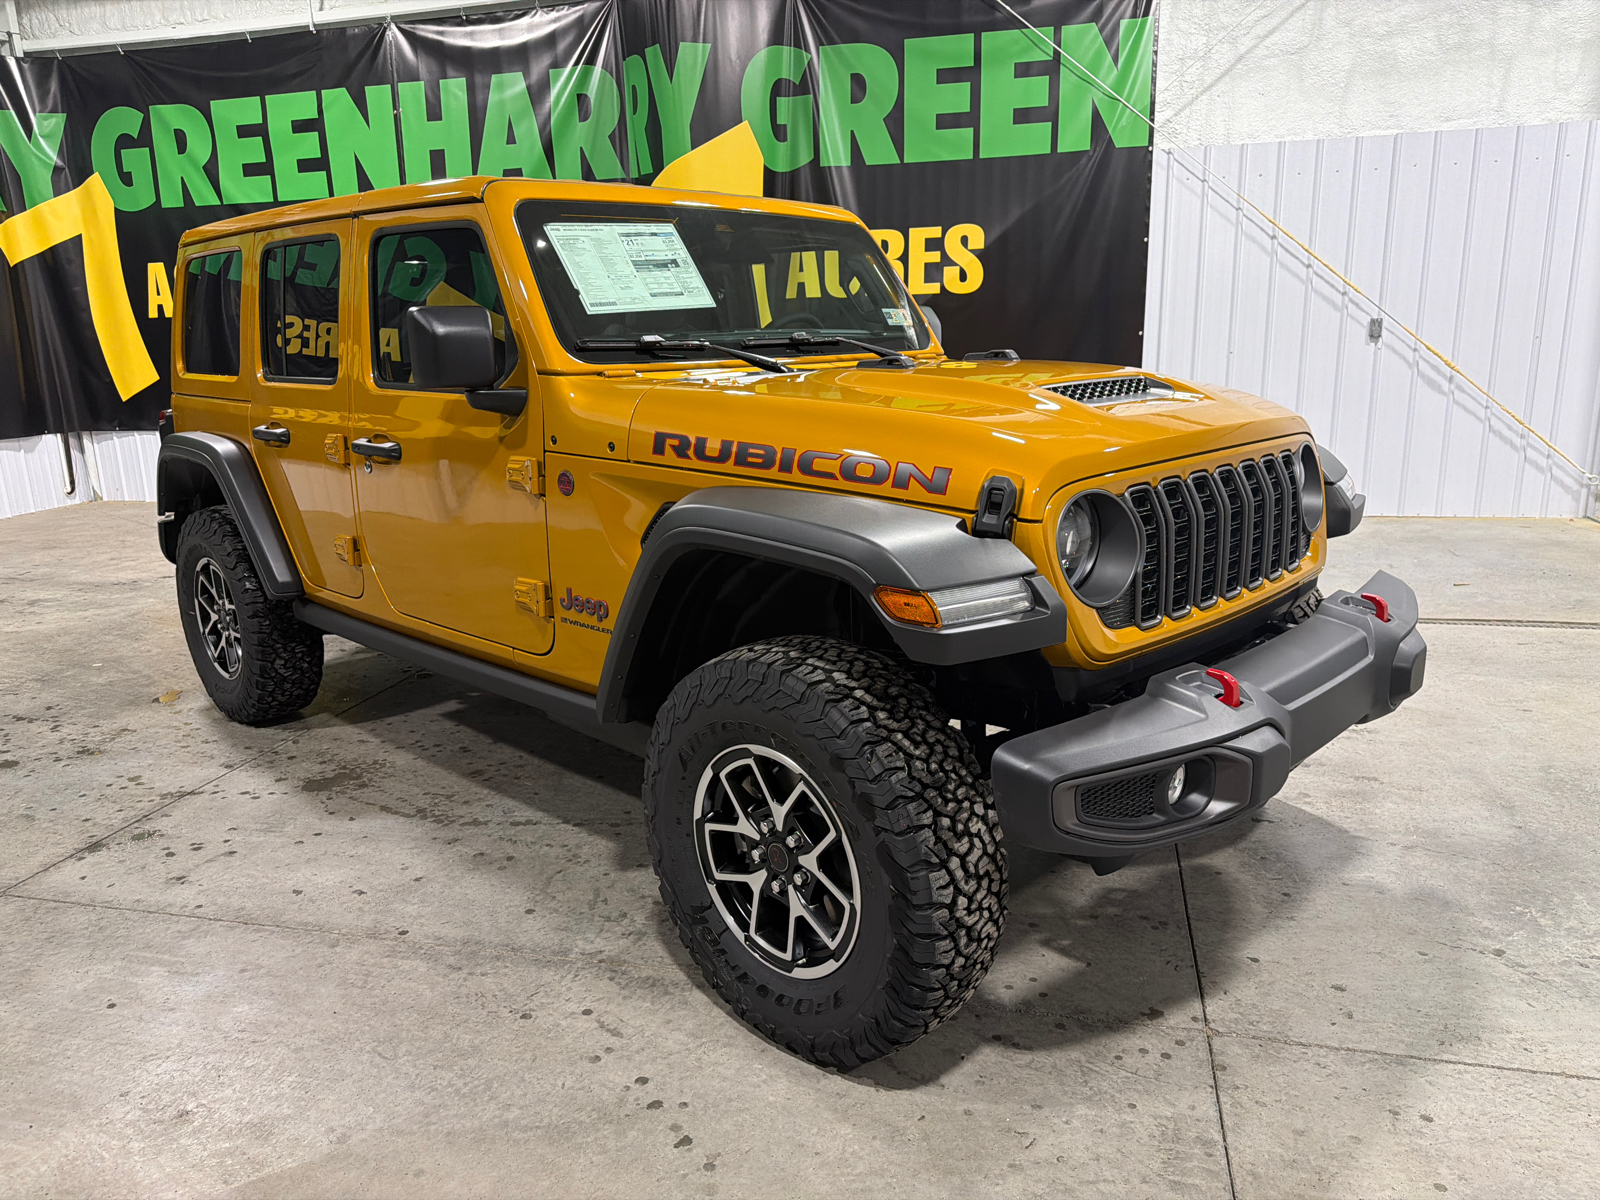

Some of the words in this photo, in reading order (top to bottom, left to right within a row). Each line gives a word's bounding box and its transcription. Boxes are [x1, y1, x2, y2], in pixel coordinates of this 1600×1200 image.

[91, 84, 400, 212] GREEN
[398, 42, 711, 184] HARRY
[741, 17, 1155, 172] GREEN
[0, 172, 160, 402] 7
[652, 430, 953, 496] RUBICON
[560, 587, 609, 622] Jeep
[568, 618, 613, 636] WRANGLER
